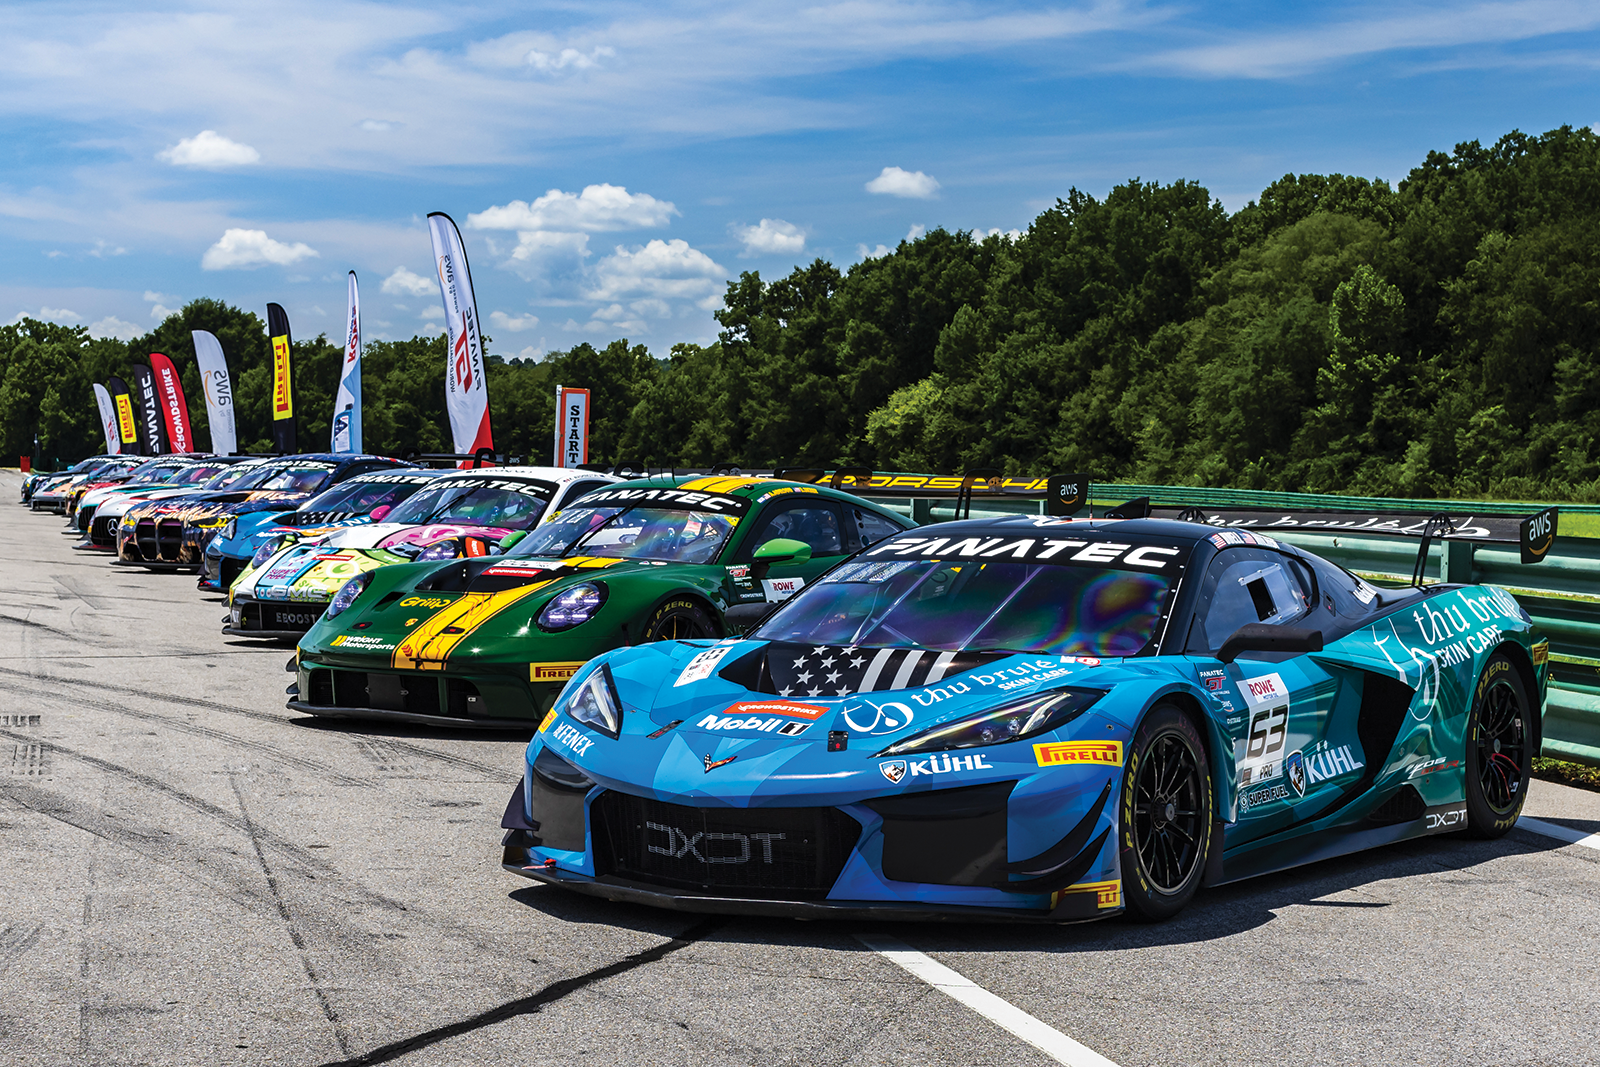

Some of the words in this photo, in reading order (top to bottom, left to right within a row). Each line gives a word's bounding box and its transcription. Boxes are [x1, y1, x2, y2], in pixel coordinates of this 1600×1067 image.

[568, 405, 580, 464] START
[348, 475, 434, 485] FANATE
[418, 480, 545, 496] FANATEC
[816, 474, 1049, 490] PORSCHE
[1060, 483, 1078, 496] aws
[566, 490, 738, 511] FANATEC
[1529, 511, 1552, 541] aws
[867, 537, 1181, 568] FANATEC
[271, 584, 328, 598] GMC
[772, 581, 795, 591] ROWE
[664, 601, 693, 612] ZERO
[1413, 602, 1471, 645] thu
[339, 642, 396, 651] Motorsports
[1435, 641, 1471, 668] SKIN
[1466, 624, 1505, 653] CARE
[997, 675, 1036, 691] SKIN
[1033, 668, 1073, 684] CARE
[1200, 669, 1224, 677] FANATEC
[1483, 661, 1509, 688] ZERO
[911, 681, 971, 706] thu
[1248, 679, 1276, 697] ROWE
[738, 704, 819, 716] CROWDSTRIKE
[696, 714, 783, 732] Mobil
[1246, 704, 1288, 761] 63
[557, 725, 595, 757] FENEX
[1041, 744, 1118, 763] PIRELLI
[1304, 739, 1365, 784] KÜHL
[909, 753, 993, 777] KÜHL
[1259, 764, 1273, 779] PRO
[1125, 752, 1139, 827] ZERO
[1249, 787, 1271, 806] SUPER
[1270, 784, 1290, 801] FUEL
